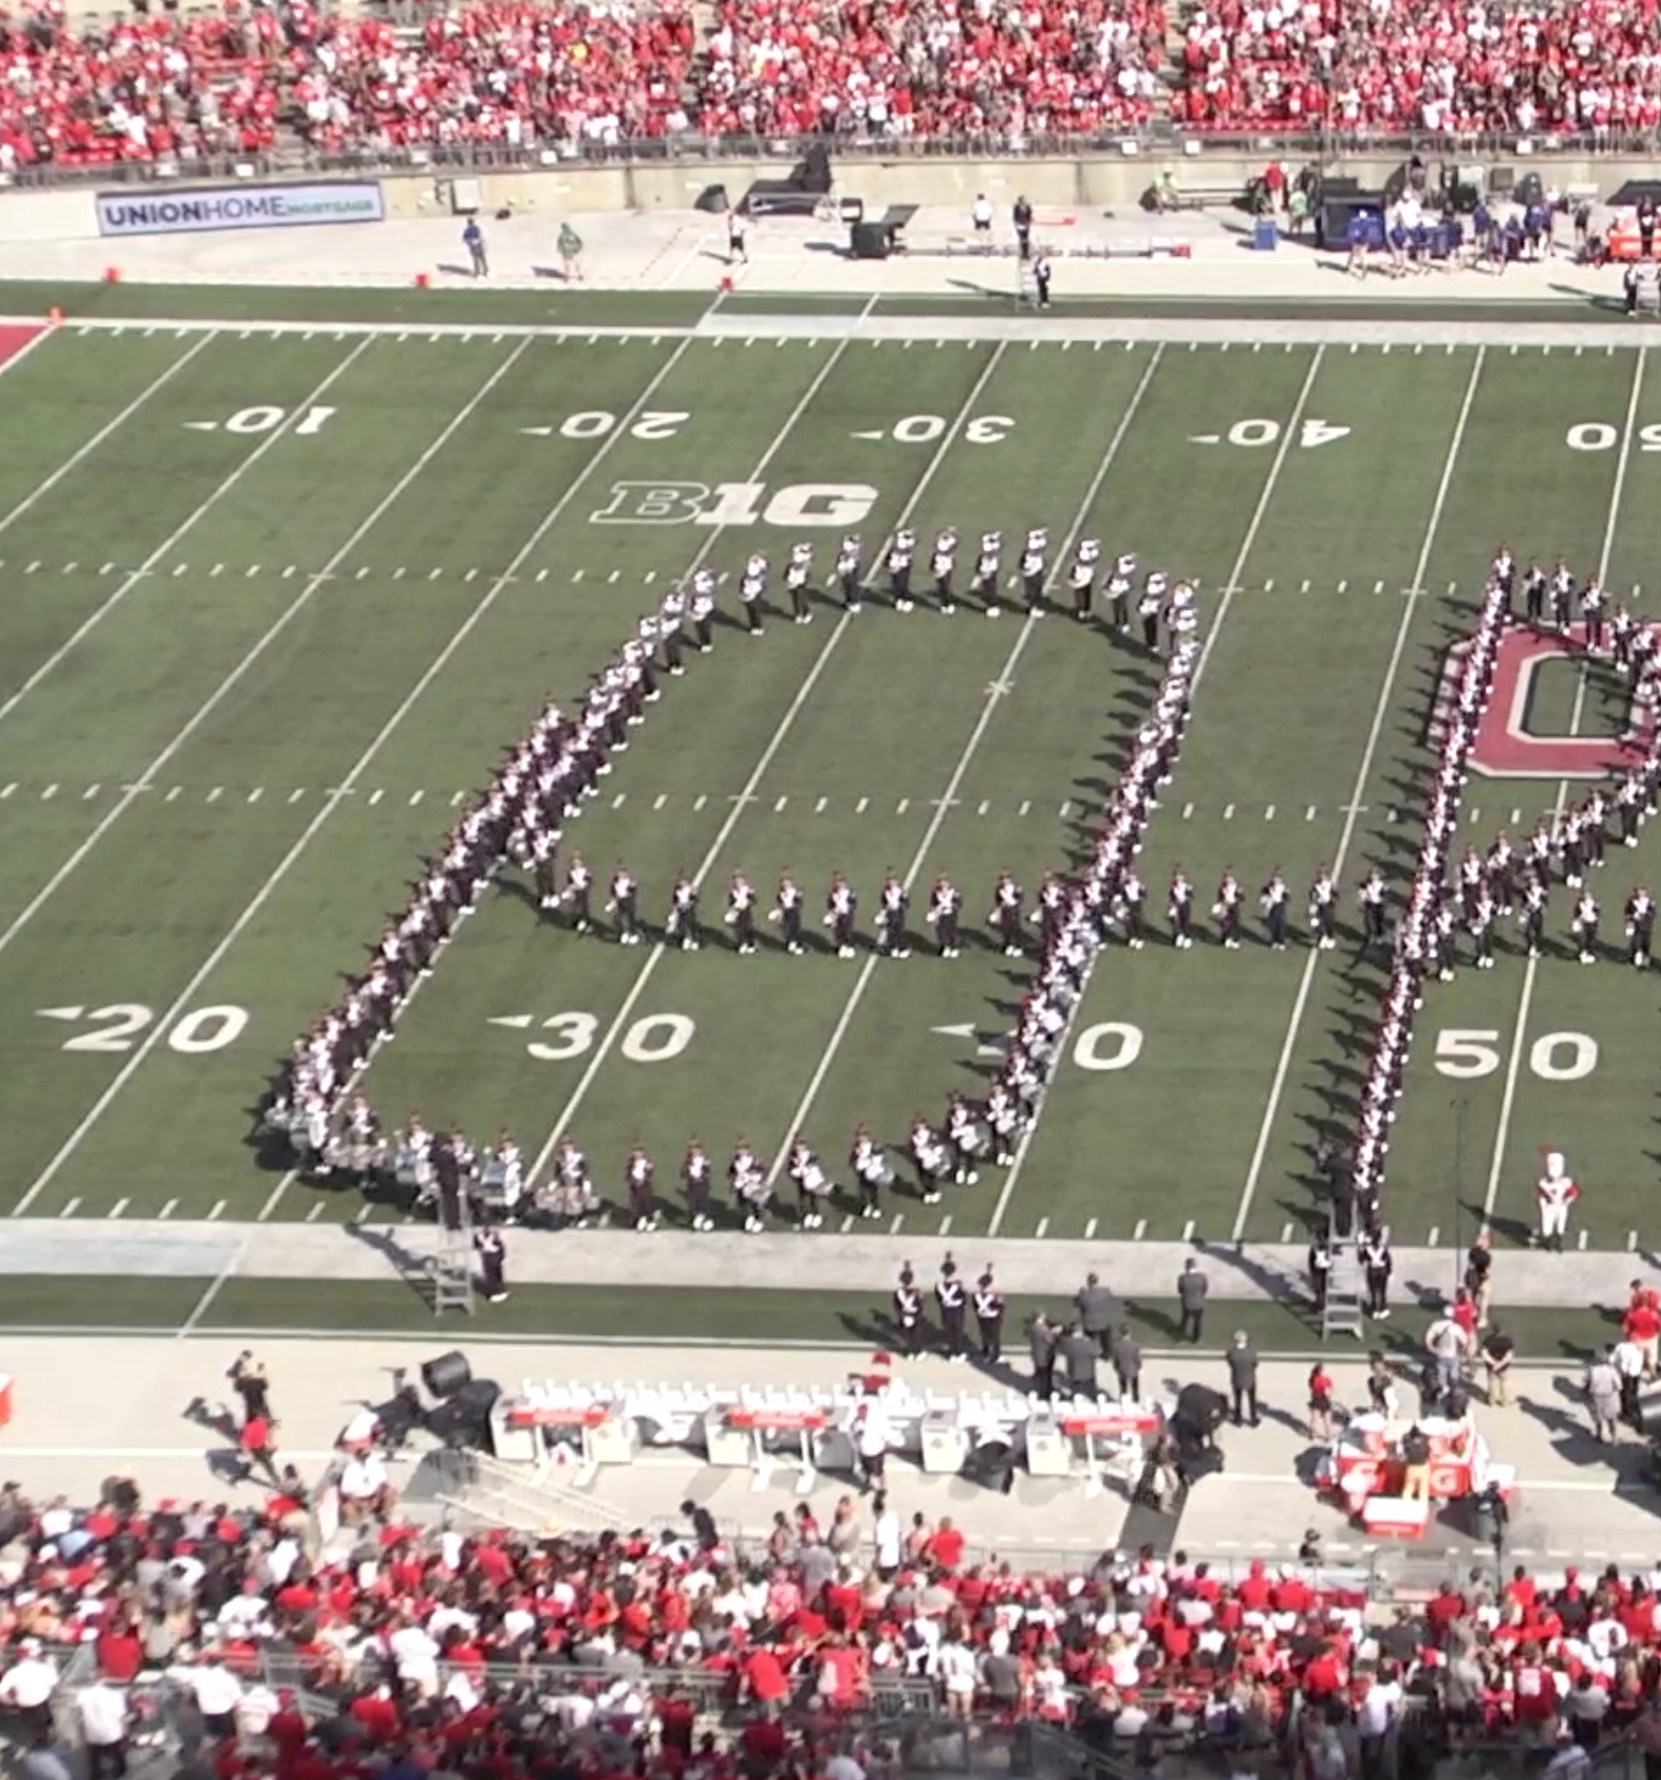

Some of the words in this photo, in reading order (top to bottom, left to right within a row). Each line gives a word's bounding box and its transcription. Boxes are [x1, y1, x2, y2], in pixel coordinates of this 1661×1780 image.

[226, 406, 336, 434] 10
[560, 412, 690, 438] 20
[893, 415, 1015, 443] 30
[1228, 419, 1350, 447] 40
[62, 1004, 248, 1052] 20
[527, 1012, 695, 1061] 30
[1434, 1029, 1598, 1080] 50
